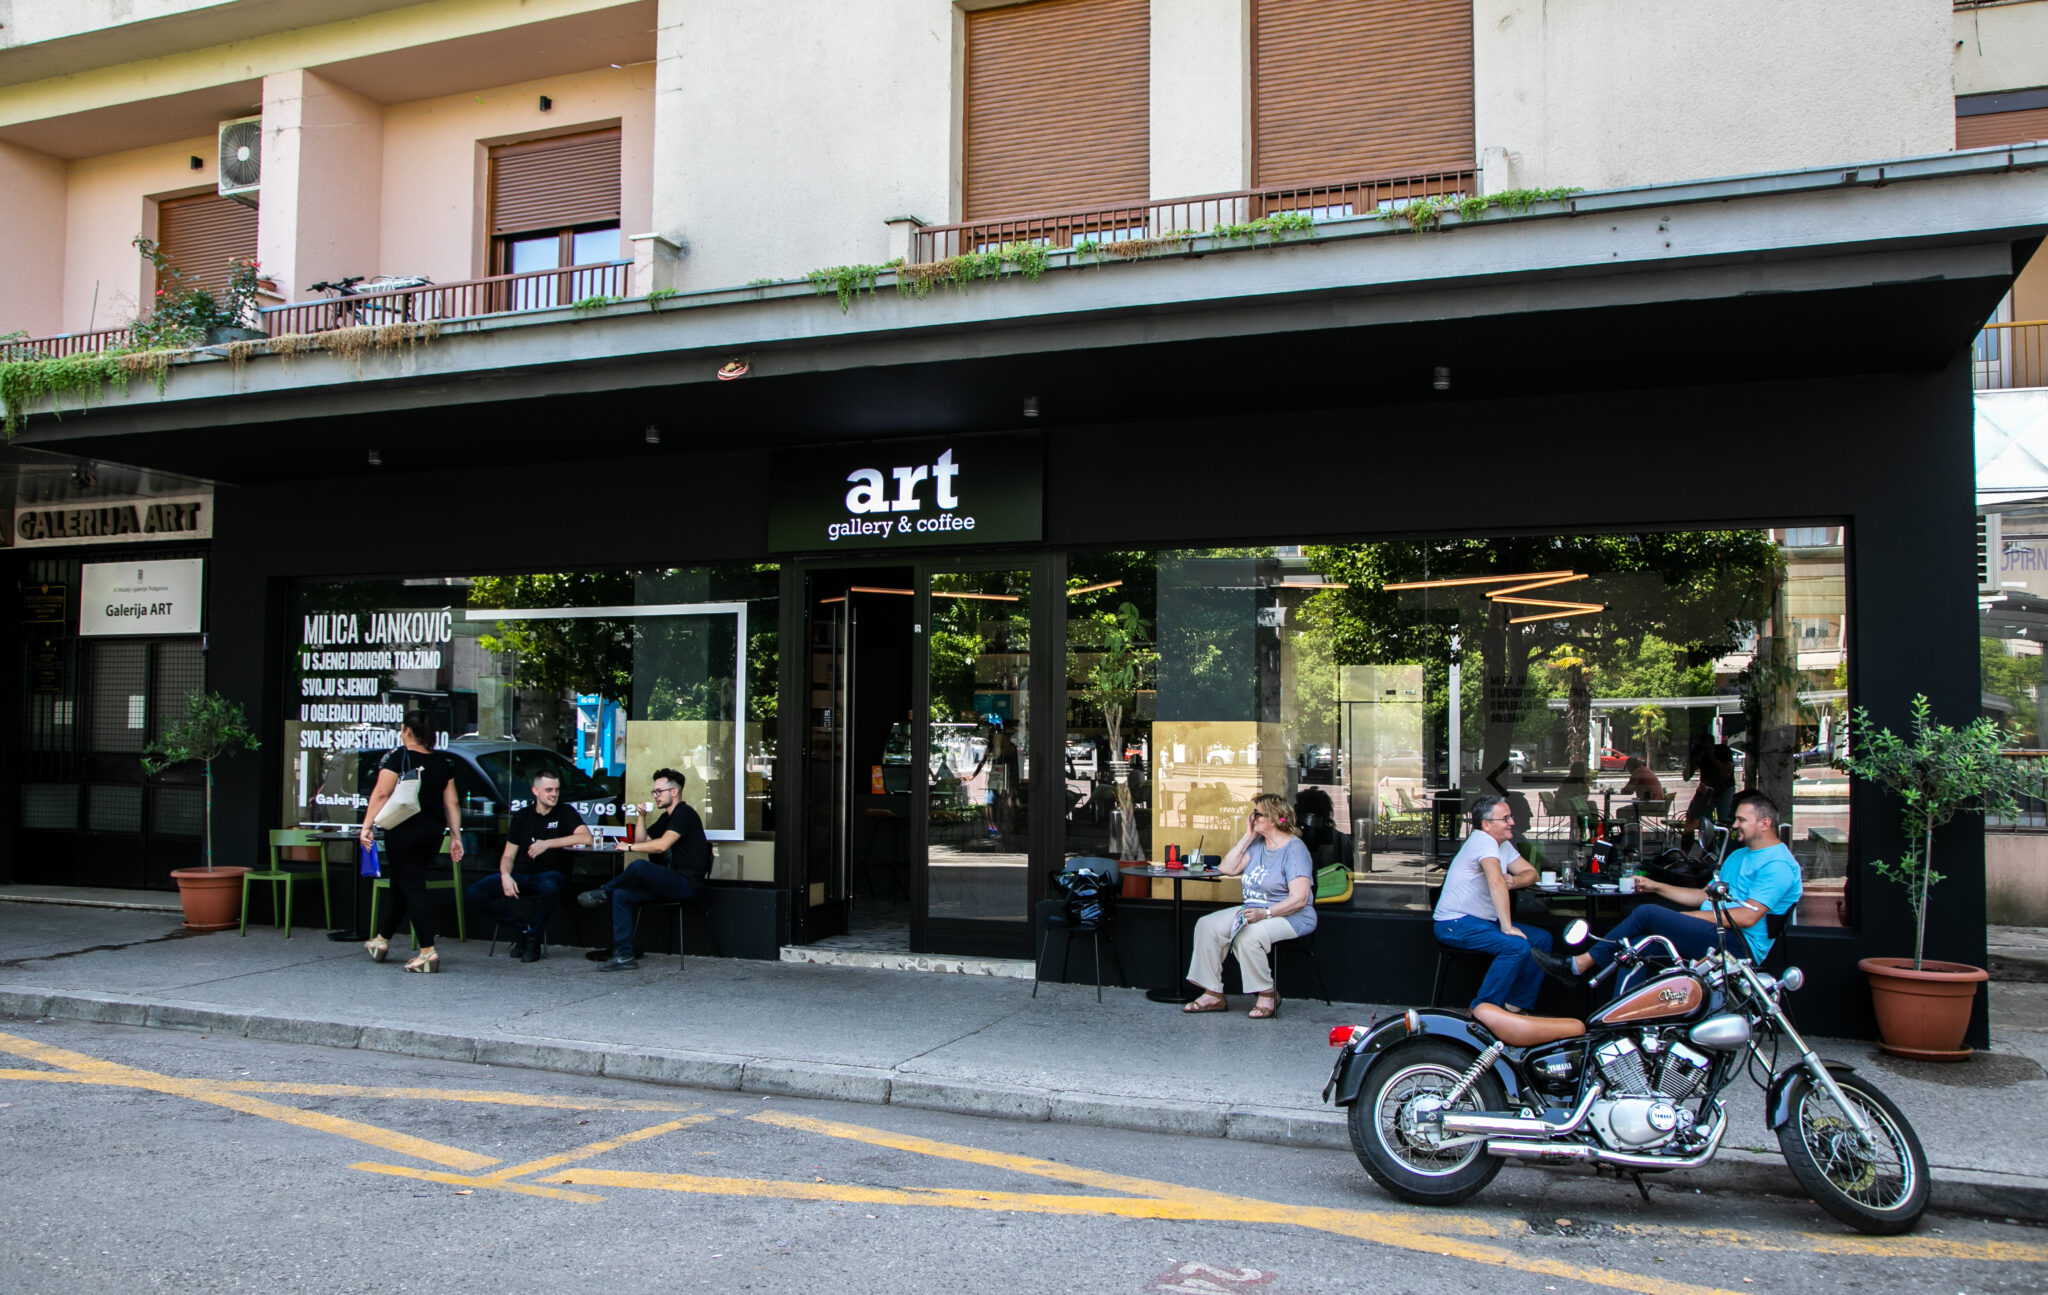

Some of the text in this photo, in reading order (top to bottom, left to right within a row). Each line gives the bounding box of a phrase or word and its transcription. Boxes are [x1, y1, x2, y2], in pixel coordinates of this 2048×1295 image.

[845, 448, 959, 514] art
[17, 502, 201, 540] GALERIJA ART
[828, 513, 976, 541] gallery & coffee
[105, 603, 173, 619] Galerija ART
[303, 605, 452, 645] MILICA JANKOVIĆ
[302, 647, 441, 671] U SJENCI DRUGOG TRAŽIMO
[301, 677, 378, 697] SVOJU SJENKU
[300, 704, 404, 723] U OGLEDALU DRUGOG
[300, 730, 333, 748] SVOJE
[334, 730, 394, 749] SOPSTVENO
[315, 793, 368, 808] Galerija
[1548, 1062, 1572, 1071] YAMAHA
